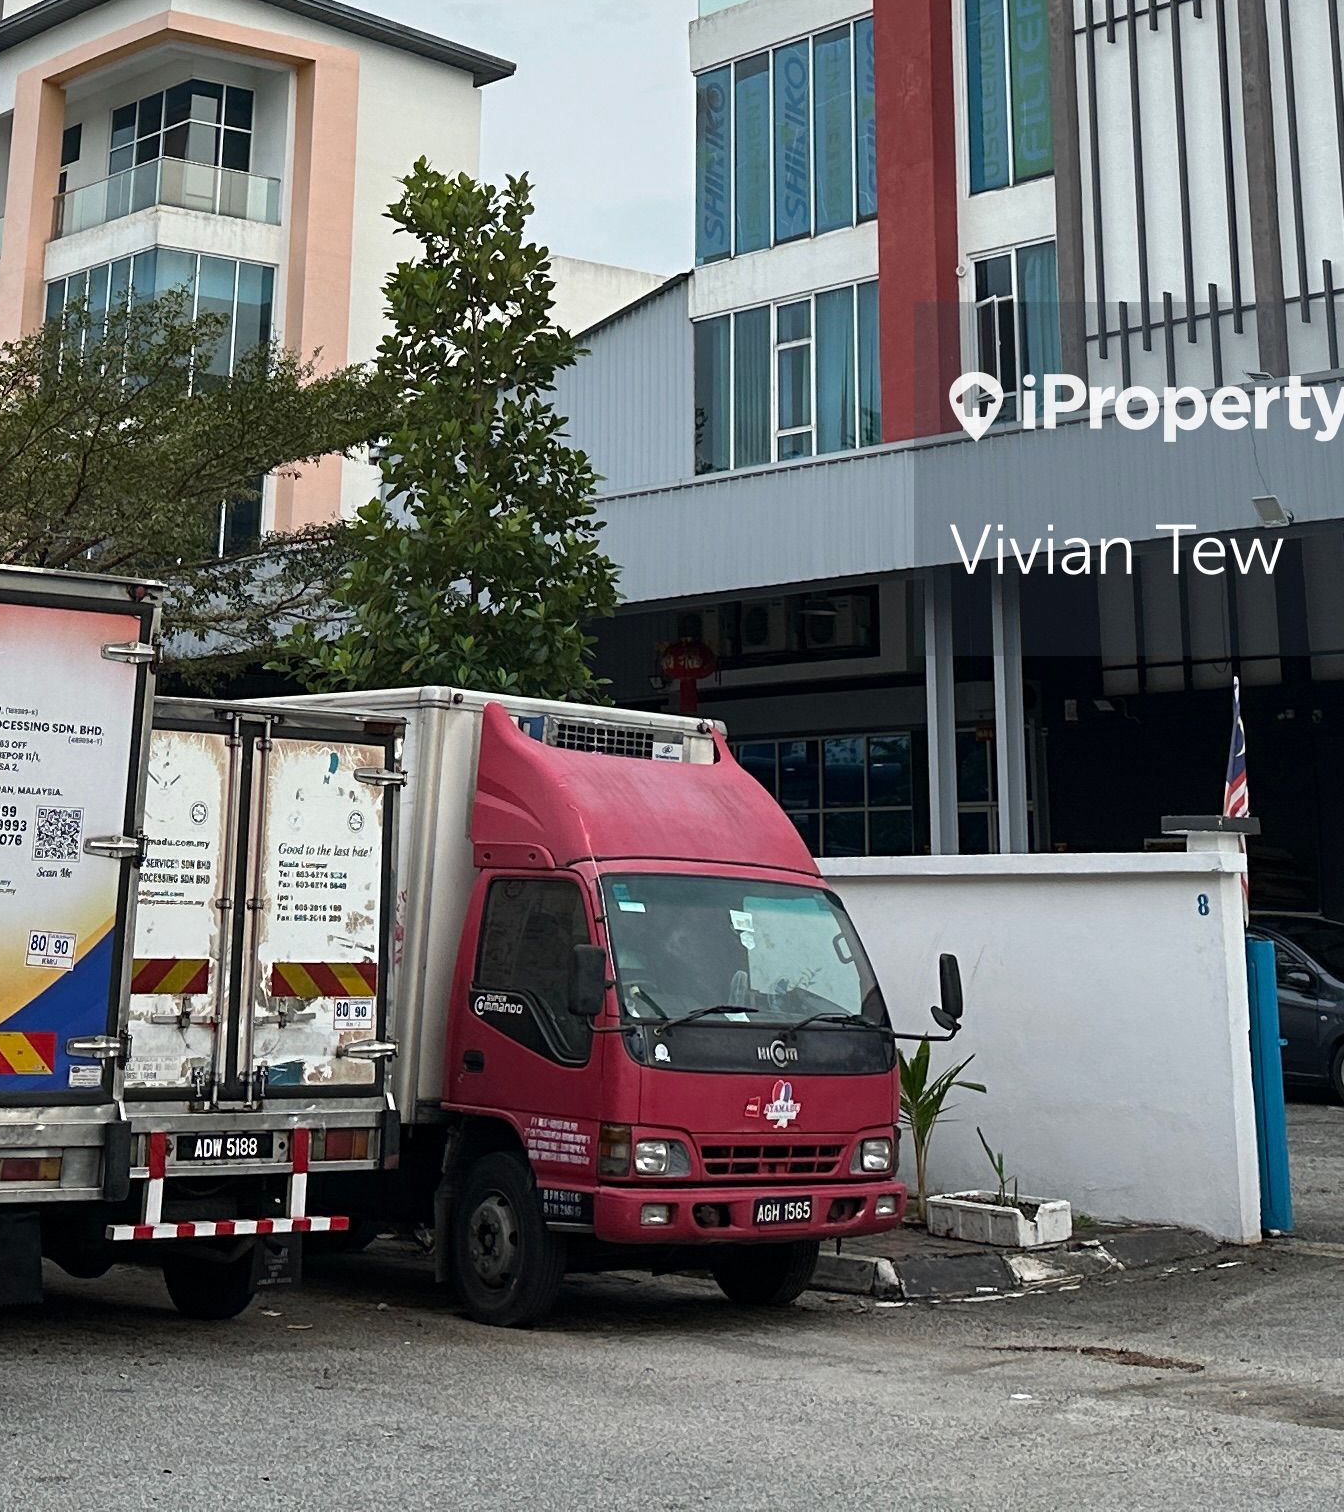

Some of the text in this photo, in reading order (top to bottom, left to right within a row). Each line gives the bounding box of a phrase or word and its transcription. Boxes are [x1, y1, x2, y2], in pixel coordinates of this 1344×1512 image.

[52, 723, 77, 734] SDN.
[80, 725, 105, 737] BHD.
[11, 740, 28, 749] OFF
[278, 842, 305, 855] Good
[305, 845, 315, 855] to
[317, 844, 332, 856] the
[333, 844, 350, 857] last
[146, 858, 211, 870] SERVICE SDN BHD
[138, 872, 211, 885] ROCESSING SDN BHD
[1197, 893, 1210, 916] 8
[30, 934, 47, 952] 80
[53, 939, 69, 955] 90
[336, 1001, 367, 1018] 80 90
[194, 1137, 258, 1158] ADW 5188
[756, 1201, 811, 1223] AGH 1565
